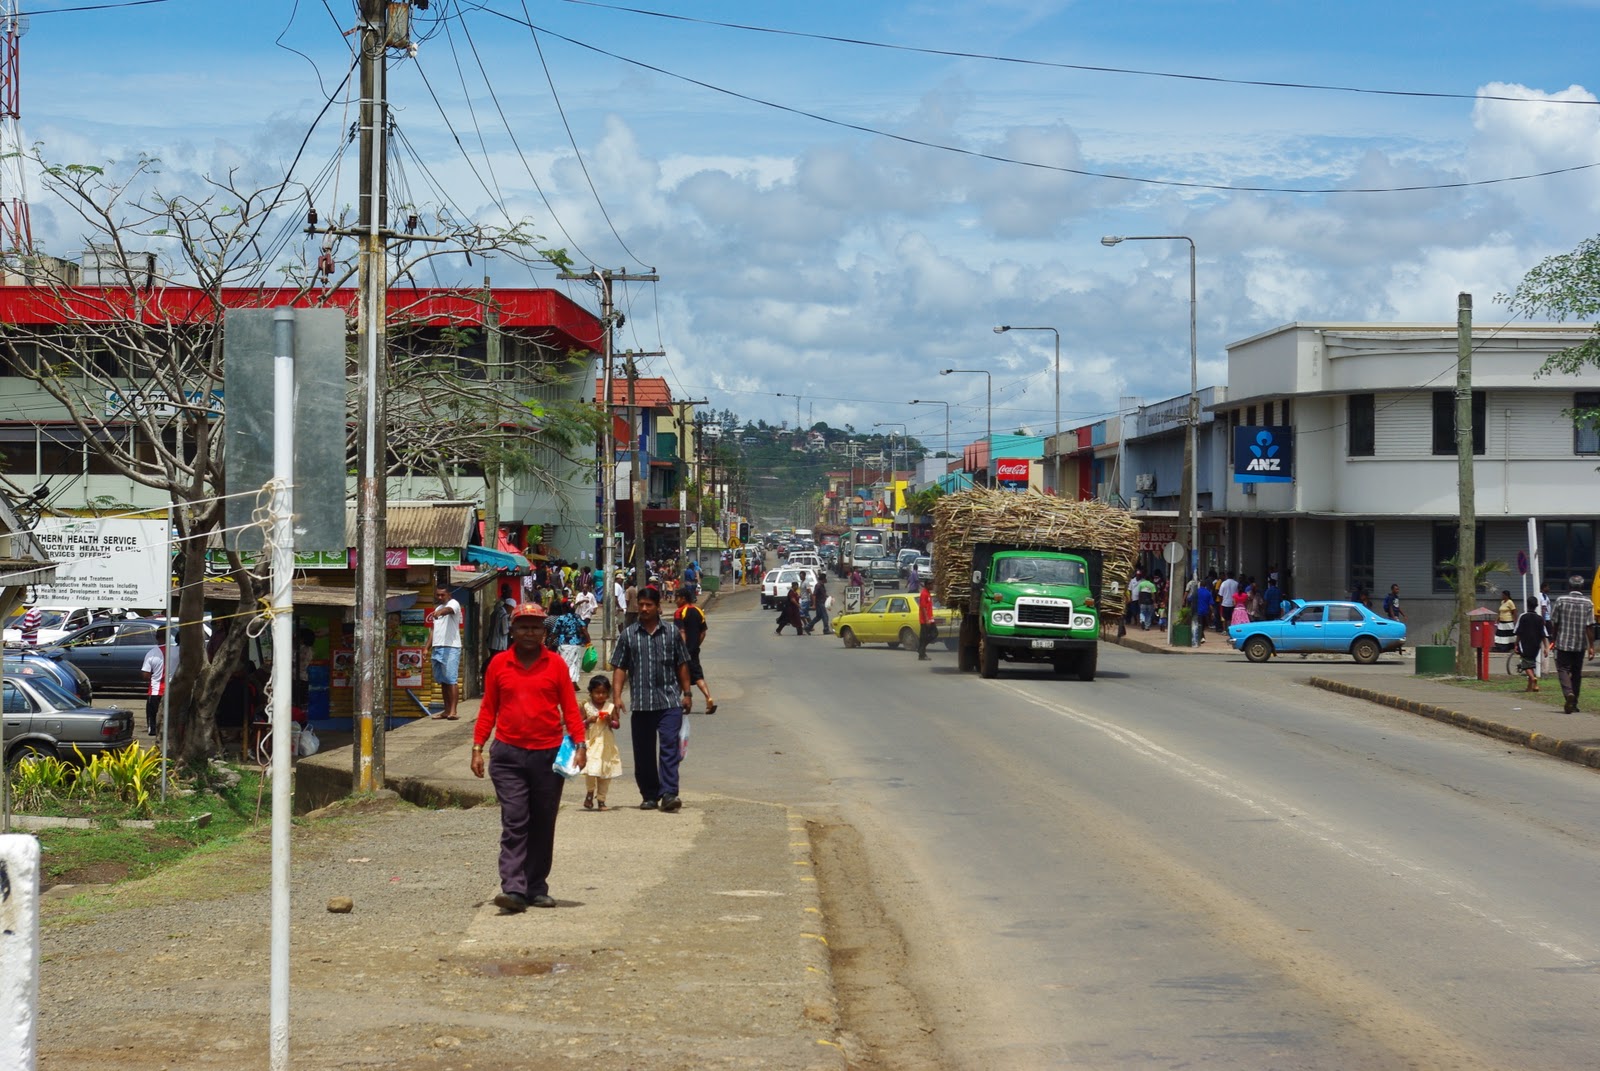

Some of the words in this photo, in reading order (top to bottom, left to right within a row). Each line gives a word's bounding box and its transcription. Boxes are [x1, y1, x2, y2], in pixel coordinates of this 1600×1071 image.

[1246, 458, 1281, 471] ANZ
[36, 534, 63, 543] THERN
[67, 535, 99, 544] HEALTH
[103, 536, 137, 545] SERVICE
